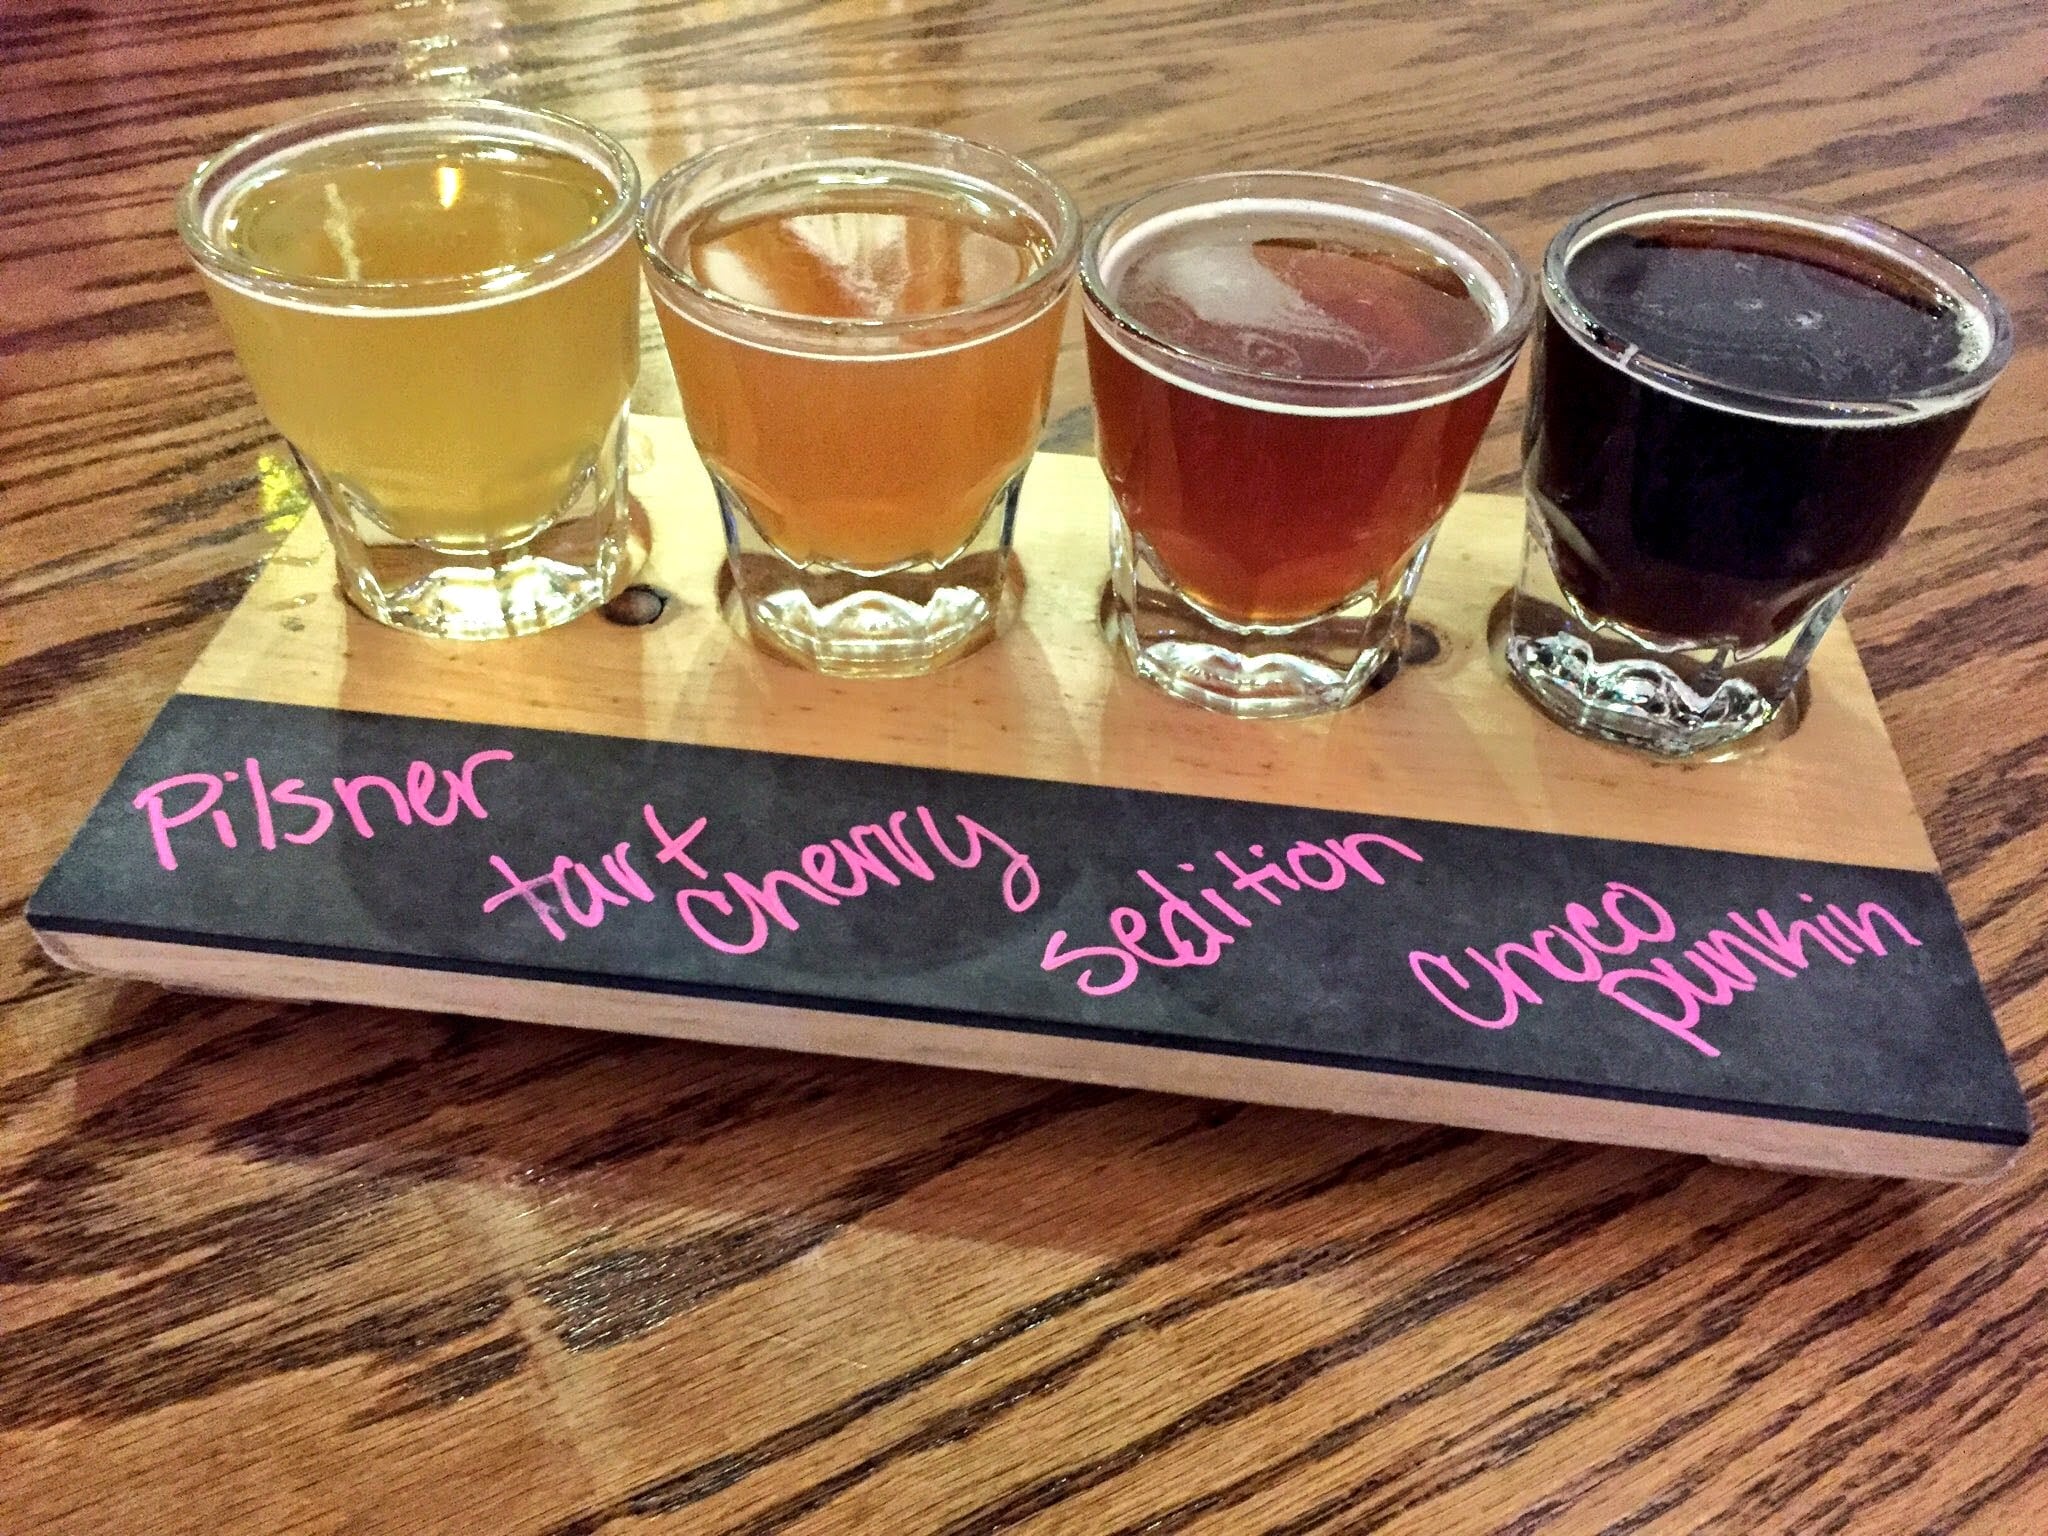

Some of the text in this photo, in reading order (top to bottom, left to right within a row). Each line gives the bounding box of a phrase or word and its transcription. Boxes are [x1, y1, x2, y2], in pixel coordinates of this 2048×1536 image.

[132, 749, 515, 871] Pilsner
[482, 804, 708, 941] tart
[675, 805, 1041, 955] Cherry
[1408, 881, 1676, 1030] Choco
